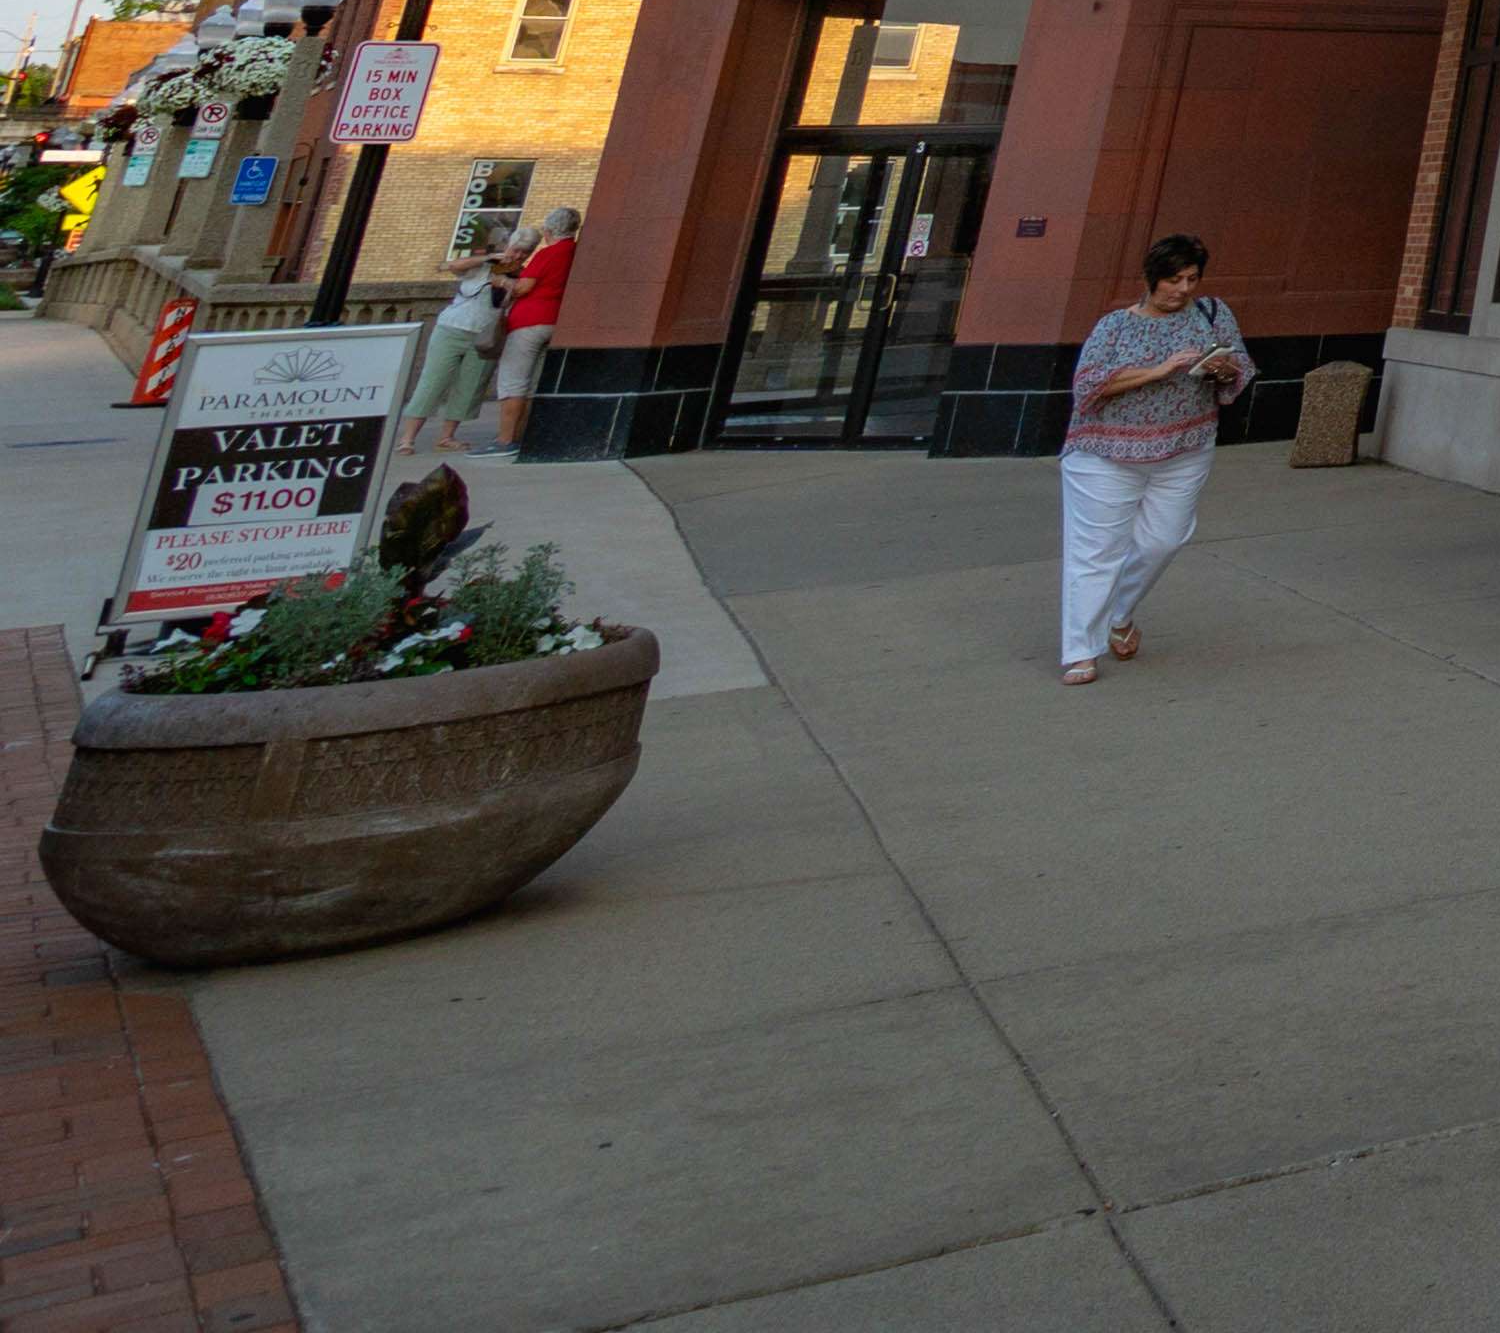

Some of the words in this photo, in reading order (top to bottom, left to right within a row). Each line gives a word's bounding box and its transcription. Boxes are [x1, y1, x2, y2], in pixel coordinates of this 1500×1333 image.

[366, 70, 383, 83] 15
[387, 70, 418, 83] MIN
[368, 88, 404, 101] BOX
[351, 105, 411, 119] OFFICE
[337, 123, 413, 137] PARKING
[915, 141, 926, 154] 3
[199, 385, 384, 411] PARAMOUNT
[250, 408, 327, 418] THEATRE
[213, 422, 354, 453] VALET
[173, 454, 366, 491] PARKING
[211, 487, 316, 516] $11.00
[156, 529, 234, 550] PLEASE
[237, 524, 292, 543] STOP
[294, 520, 352, 538] HERE
[165, 552, 202, 572] $20
